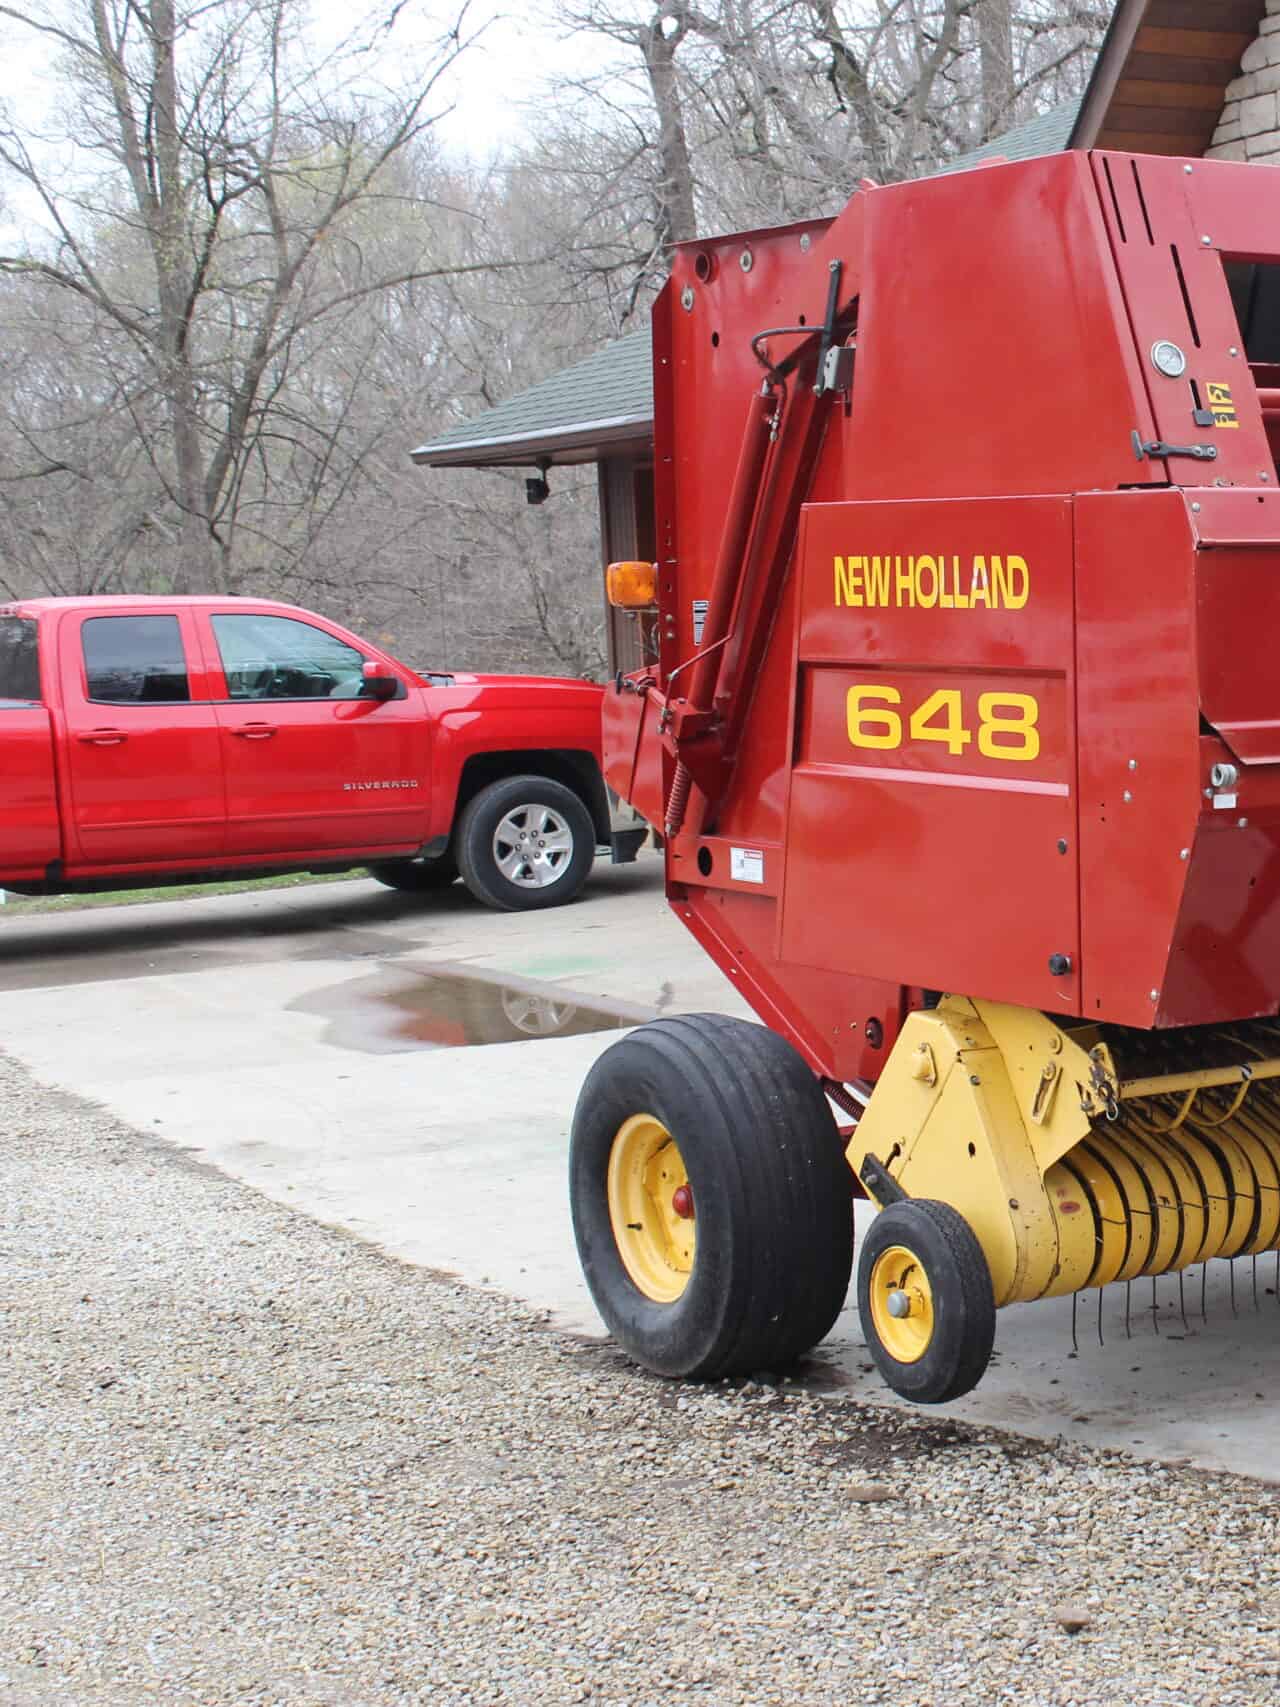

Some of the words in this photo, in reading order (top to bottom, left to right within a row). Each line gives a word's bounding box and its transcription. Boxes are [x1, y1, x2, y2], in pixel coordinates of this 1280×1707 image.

[833, 555, 890, 607] NEW
[895, 554, 1030, 610] HOLLAND
[846, 684, 1040, 761] 648
[343, 779, 418, 792] SILVERADO
